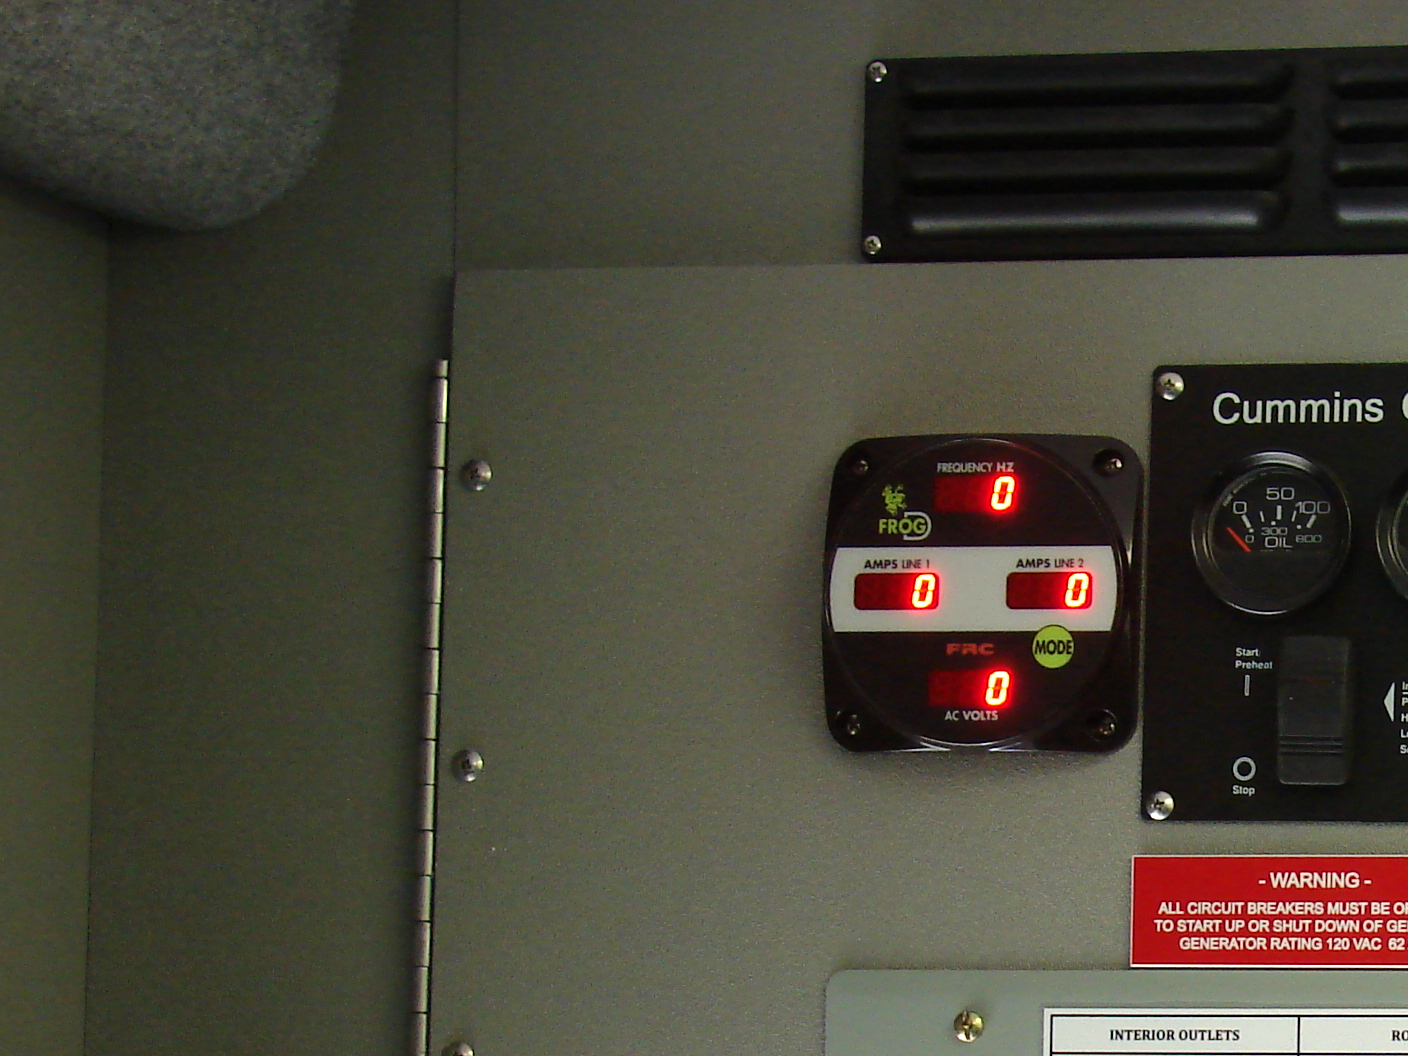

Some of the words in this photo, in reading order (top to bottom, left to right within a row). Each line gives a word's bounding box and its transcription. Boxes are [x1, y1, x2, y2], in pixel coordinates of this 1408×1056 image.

[1213, 391, 1384, 425] Cummins
[937, 462, 993, 473] FREQUENCY
[996, 462, 1015, 473] HZ
[991, 475, 1015, 511] 0
[1266, 487, 1295, 501] 50
[1233, 501, 1247, 515] 0
[1295, 501, 1331, 514] 100
[878, 518, 927, 535] FROG
[1261, 527, 1288, 536] 300
[1245, 535, 1255, 543] 0
[1264, 536, 1293, 548] OIL
[864, 559, 898, 569] AMPS
[902, 559, 922, 569] LINE
[925, 559, 930, 569] 1
[1016, 559, 1051, 569] AMPS
[1054, 559, 1075, 568] LINE
[1077, 558, 1084, 568] 2
[911, 573, 936, 608] 0
[1064, 572, 1089, 607] 0
[946, 642, 994, 655] FRC
[1034, 640, 1073, 655] MODE
[1235, 647, 1259, 657] Start
[1235, 660, 1273, 670] Preheat
[985, 670, 1010, 706] 0
[944, 711, 959, 720] AC
[963, 710, 999, 720] VOLTS
[1232, 785, 1255, 796] Stop
[1269, 872, 1360, 889] WARNING
[1157, 902, 1185, 915] ALL
[1187, 902, 1245, 915] CIRCUIT
[1247, 902, 1325, 915] BREAKERS
[1327, 902, 1369, 915] MUST
[1370, 902, 1391, 915] BE
[1154, 919, 1174, 932] TO
[1176, 919, 1223, 932] START
[1225, 919, 1246, 932] UP
[1248, 919, 1270, 932] OR
[1272, 919, 1313, 932] SHUT
[1315, 919, 1360, 933] DOWN
[1362, 919, 1383, 932] OF
[1179, 937, 1267, 950] GENERATOR
[1270, 937, 1323, 950] RATING
[1326, 937, 1350, 951] 120
[1352, 937, 1382, 951] VAC
[1388, 937, 1405, 950] 62
[1109, 1029, 1175, 1041] INTERIOR
[1178, 1029, 1240, 1041] OUTLETS
